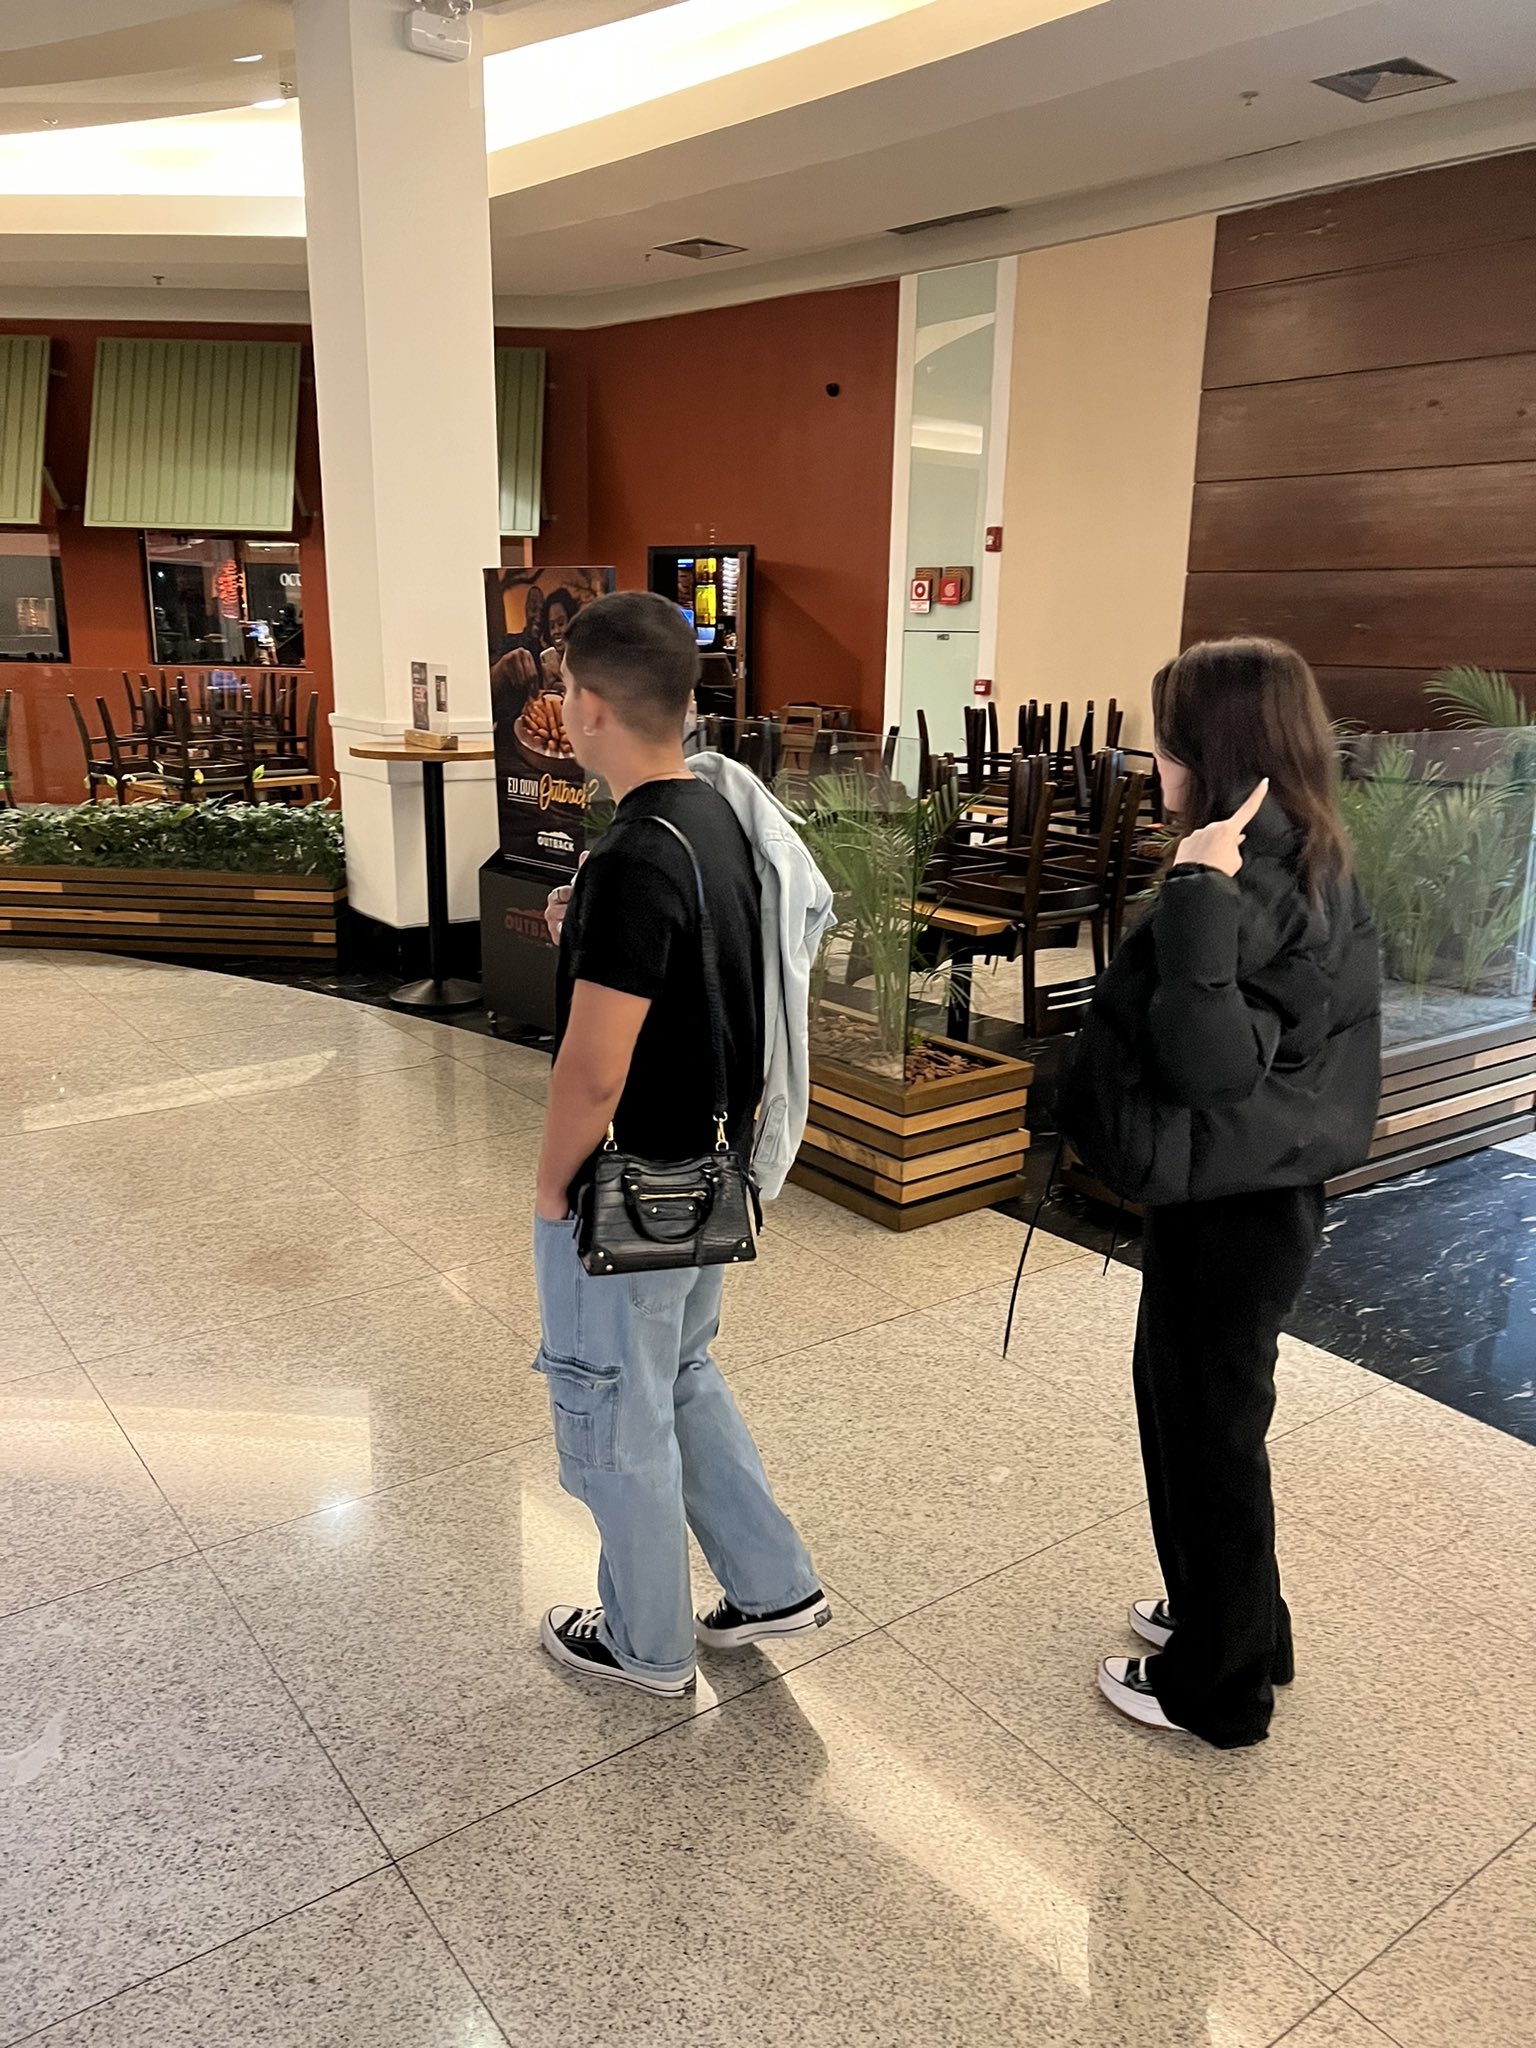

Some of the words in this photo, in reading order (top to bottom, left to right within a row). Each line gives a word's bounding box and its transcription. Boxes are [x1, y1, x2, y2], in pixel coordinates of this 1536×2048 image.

[507, 776, 518, 793] EU
[520, 778, 538, 796] OUVI
[537, 836, 574, 852] OUTBACK
[505, 914, 549, 939] OUTBA
